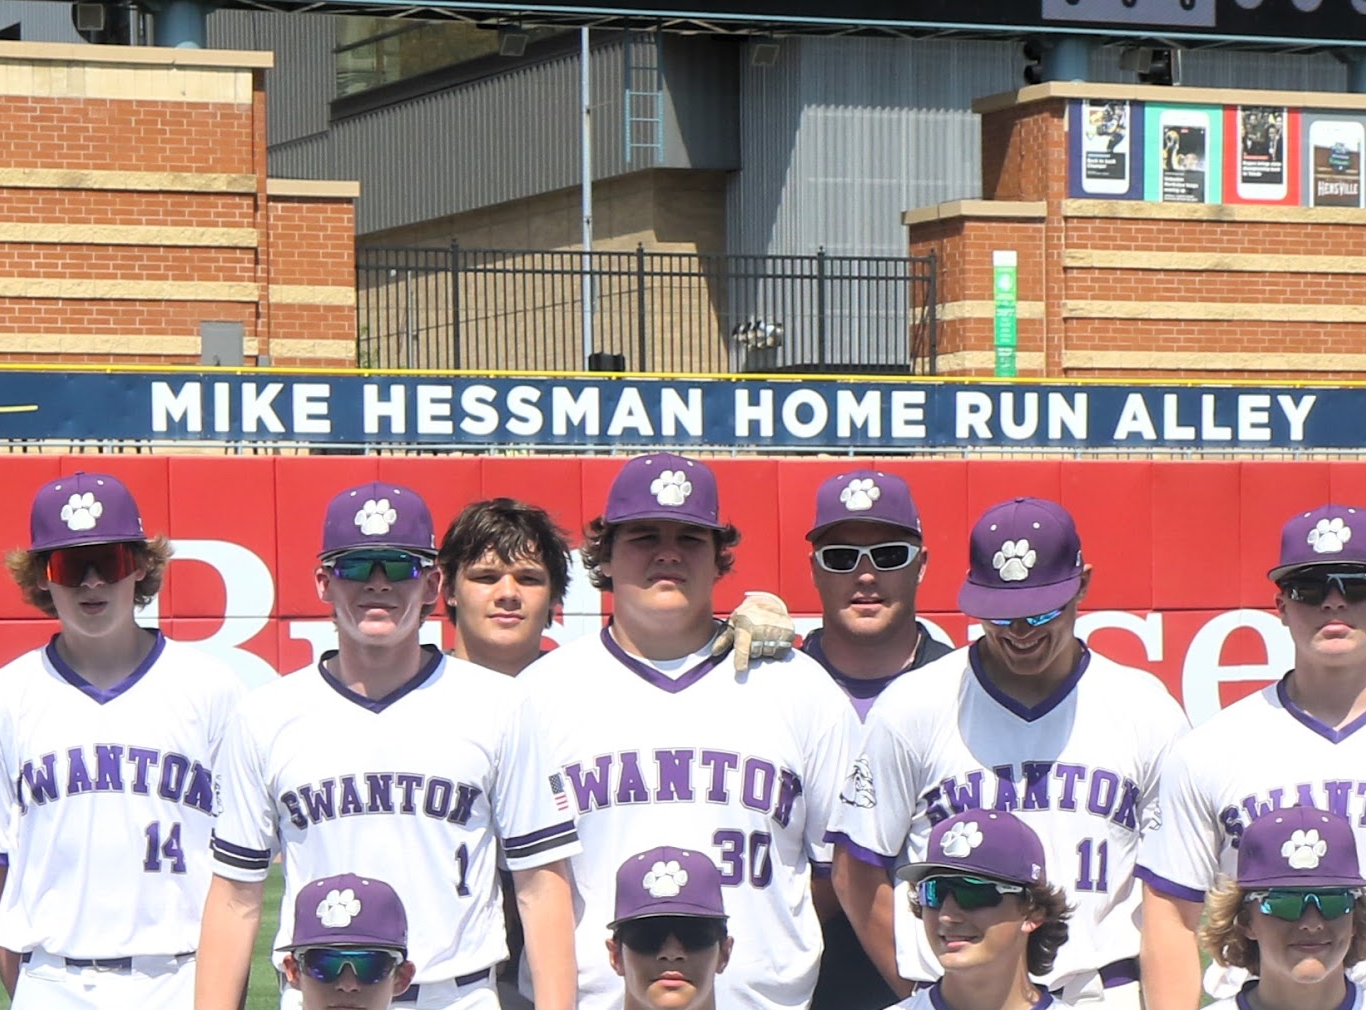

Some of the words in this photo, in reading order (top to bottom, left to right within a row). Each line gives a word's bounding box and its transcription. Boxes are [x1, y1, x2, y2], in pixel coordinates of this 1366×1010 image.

[151, 381, 331, 434] MIKE
[363, 384, 703, 436] HESSMAN
[734, 388, 926, 438] HOME
[955, 391, 1088, 440] RUN
[1112, 394, 1317, 440] ALLEY
[17, 743, 213, 816] WANTON
[281, 772, 483, 831] SWANTON
[563, 748, 803, 829] WANTON
[143, 820, 186, 874] 14
[455, 843, 473, 899] 1
[712, 828, 772, 889] 30
[1075, 837, 1109, 893] 11
